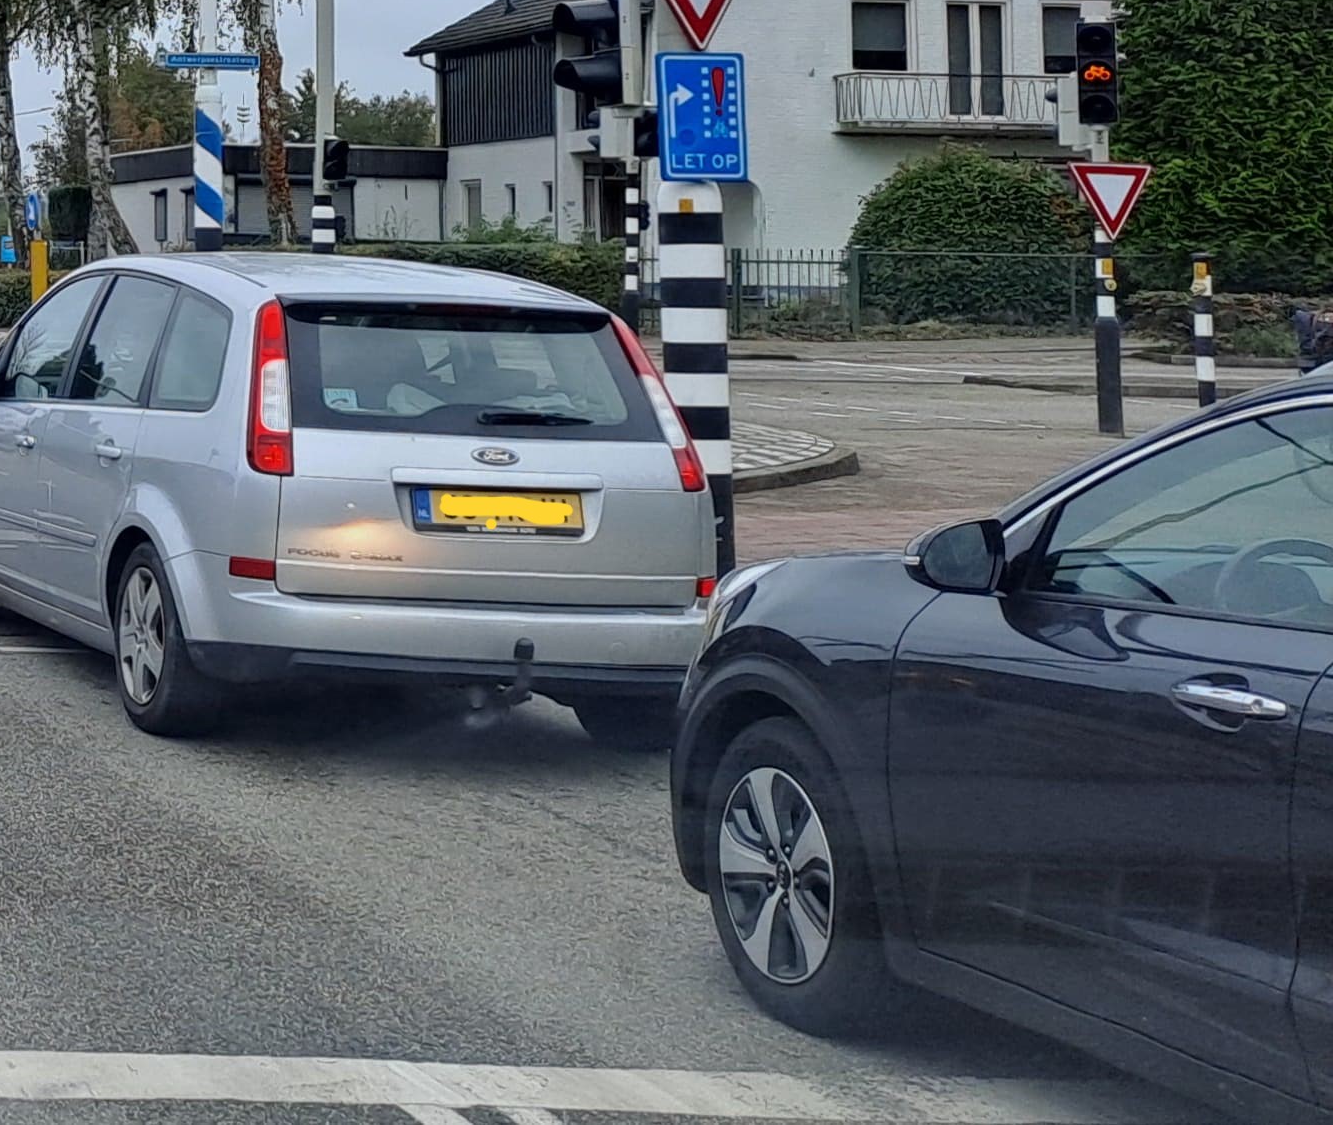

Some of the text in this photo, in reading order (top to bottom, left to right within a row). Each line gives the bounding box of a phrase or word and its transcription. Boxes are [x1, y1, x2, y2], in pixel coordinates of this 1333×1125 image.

[671, 153, 738, 169] LET OP
[417, 508, 431, 519] NL
[287, 547, 403, 562] FOCUS C-MAX
